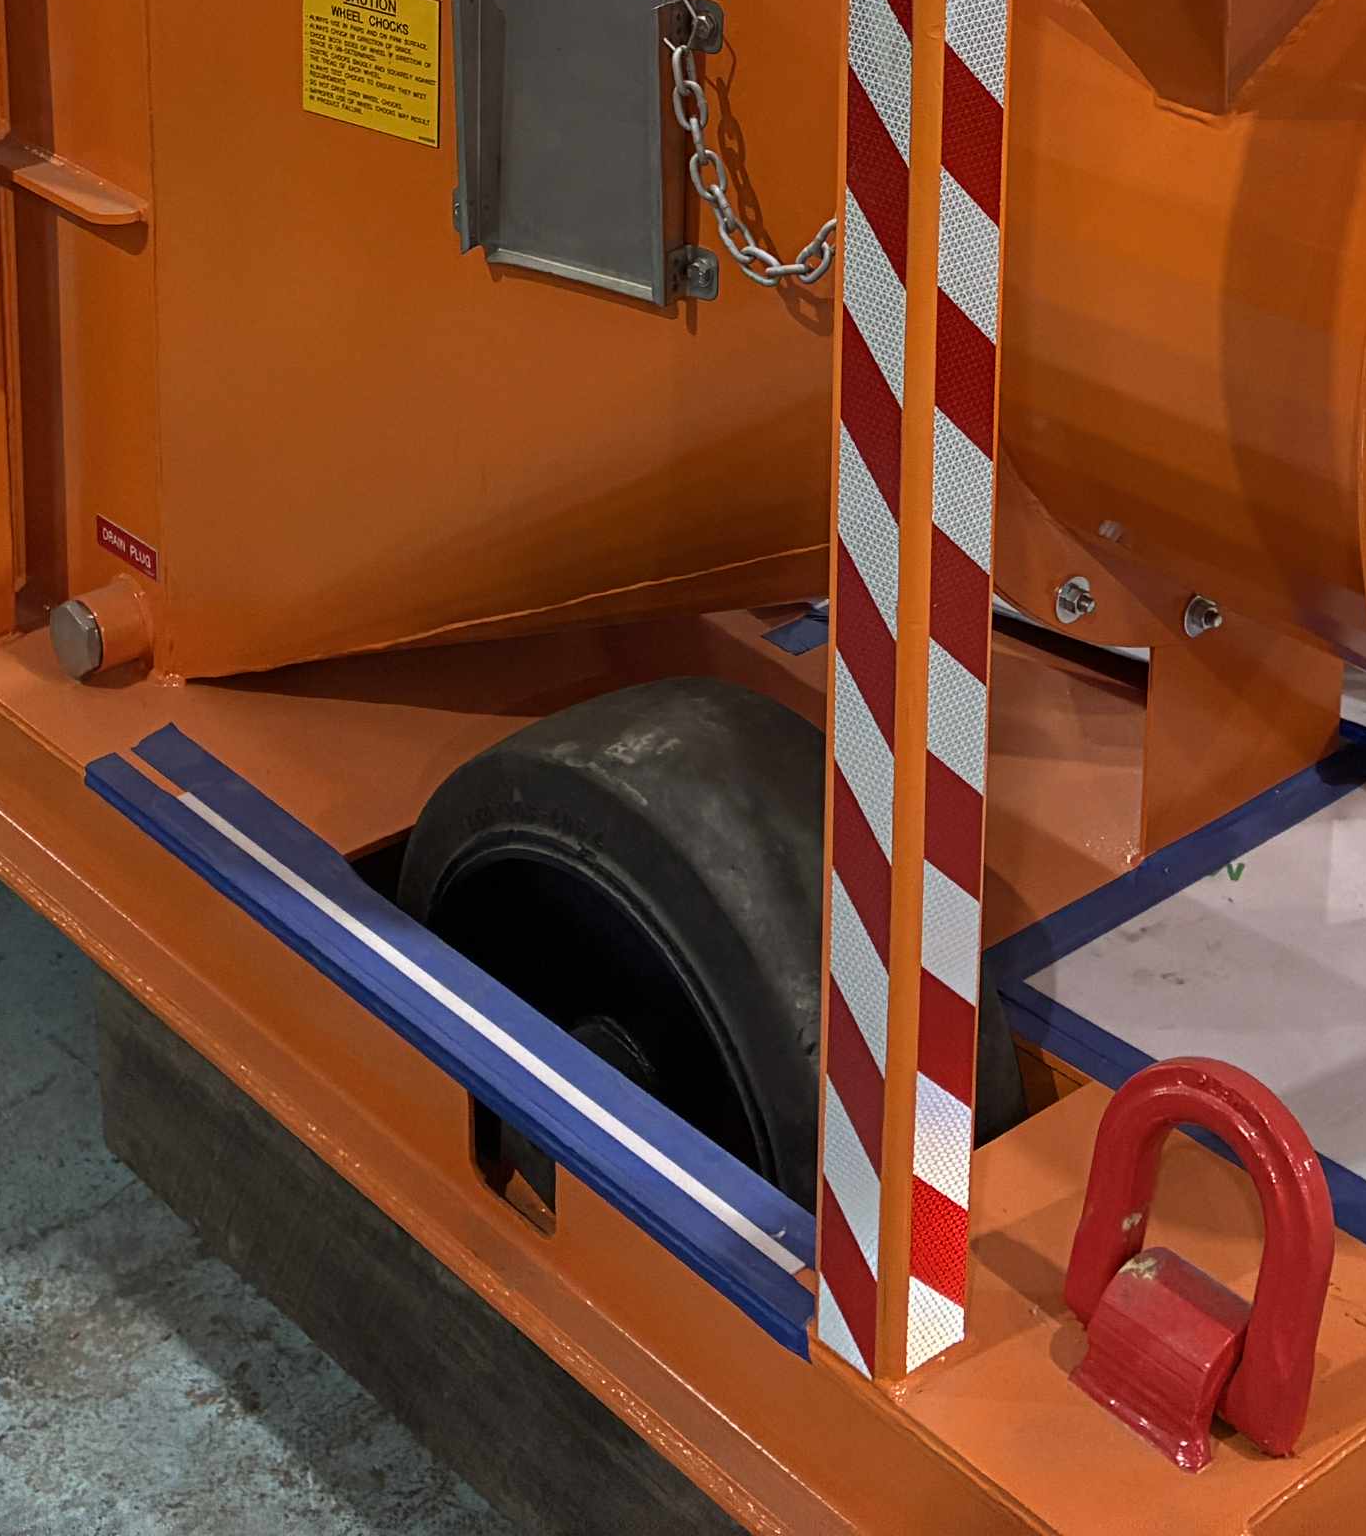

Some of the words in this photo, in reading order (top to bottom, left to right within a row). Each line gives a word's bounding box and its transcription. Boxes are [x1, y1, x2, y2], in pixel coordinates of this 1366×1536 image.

[331, 5, 363, 24] WHEEL
[369, 15, 409, 36] CHOCKS
[102, 527, 126, 553] DRAIN
[129, 544, 151, 569] PLUG
